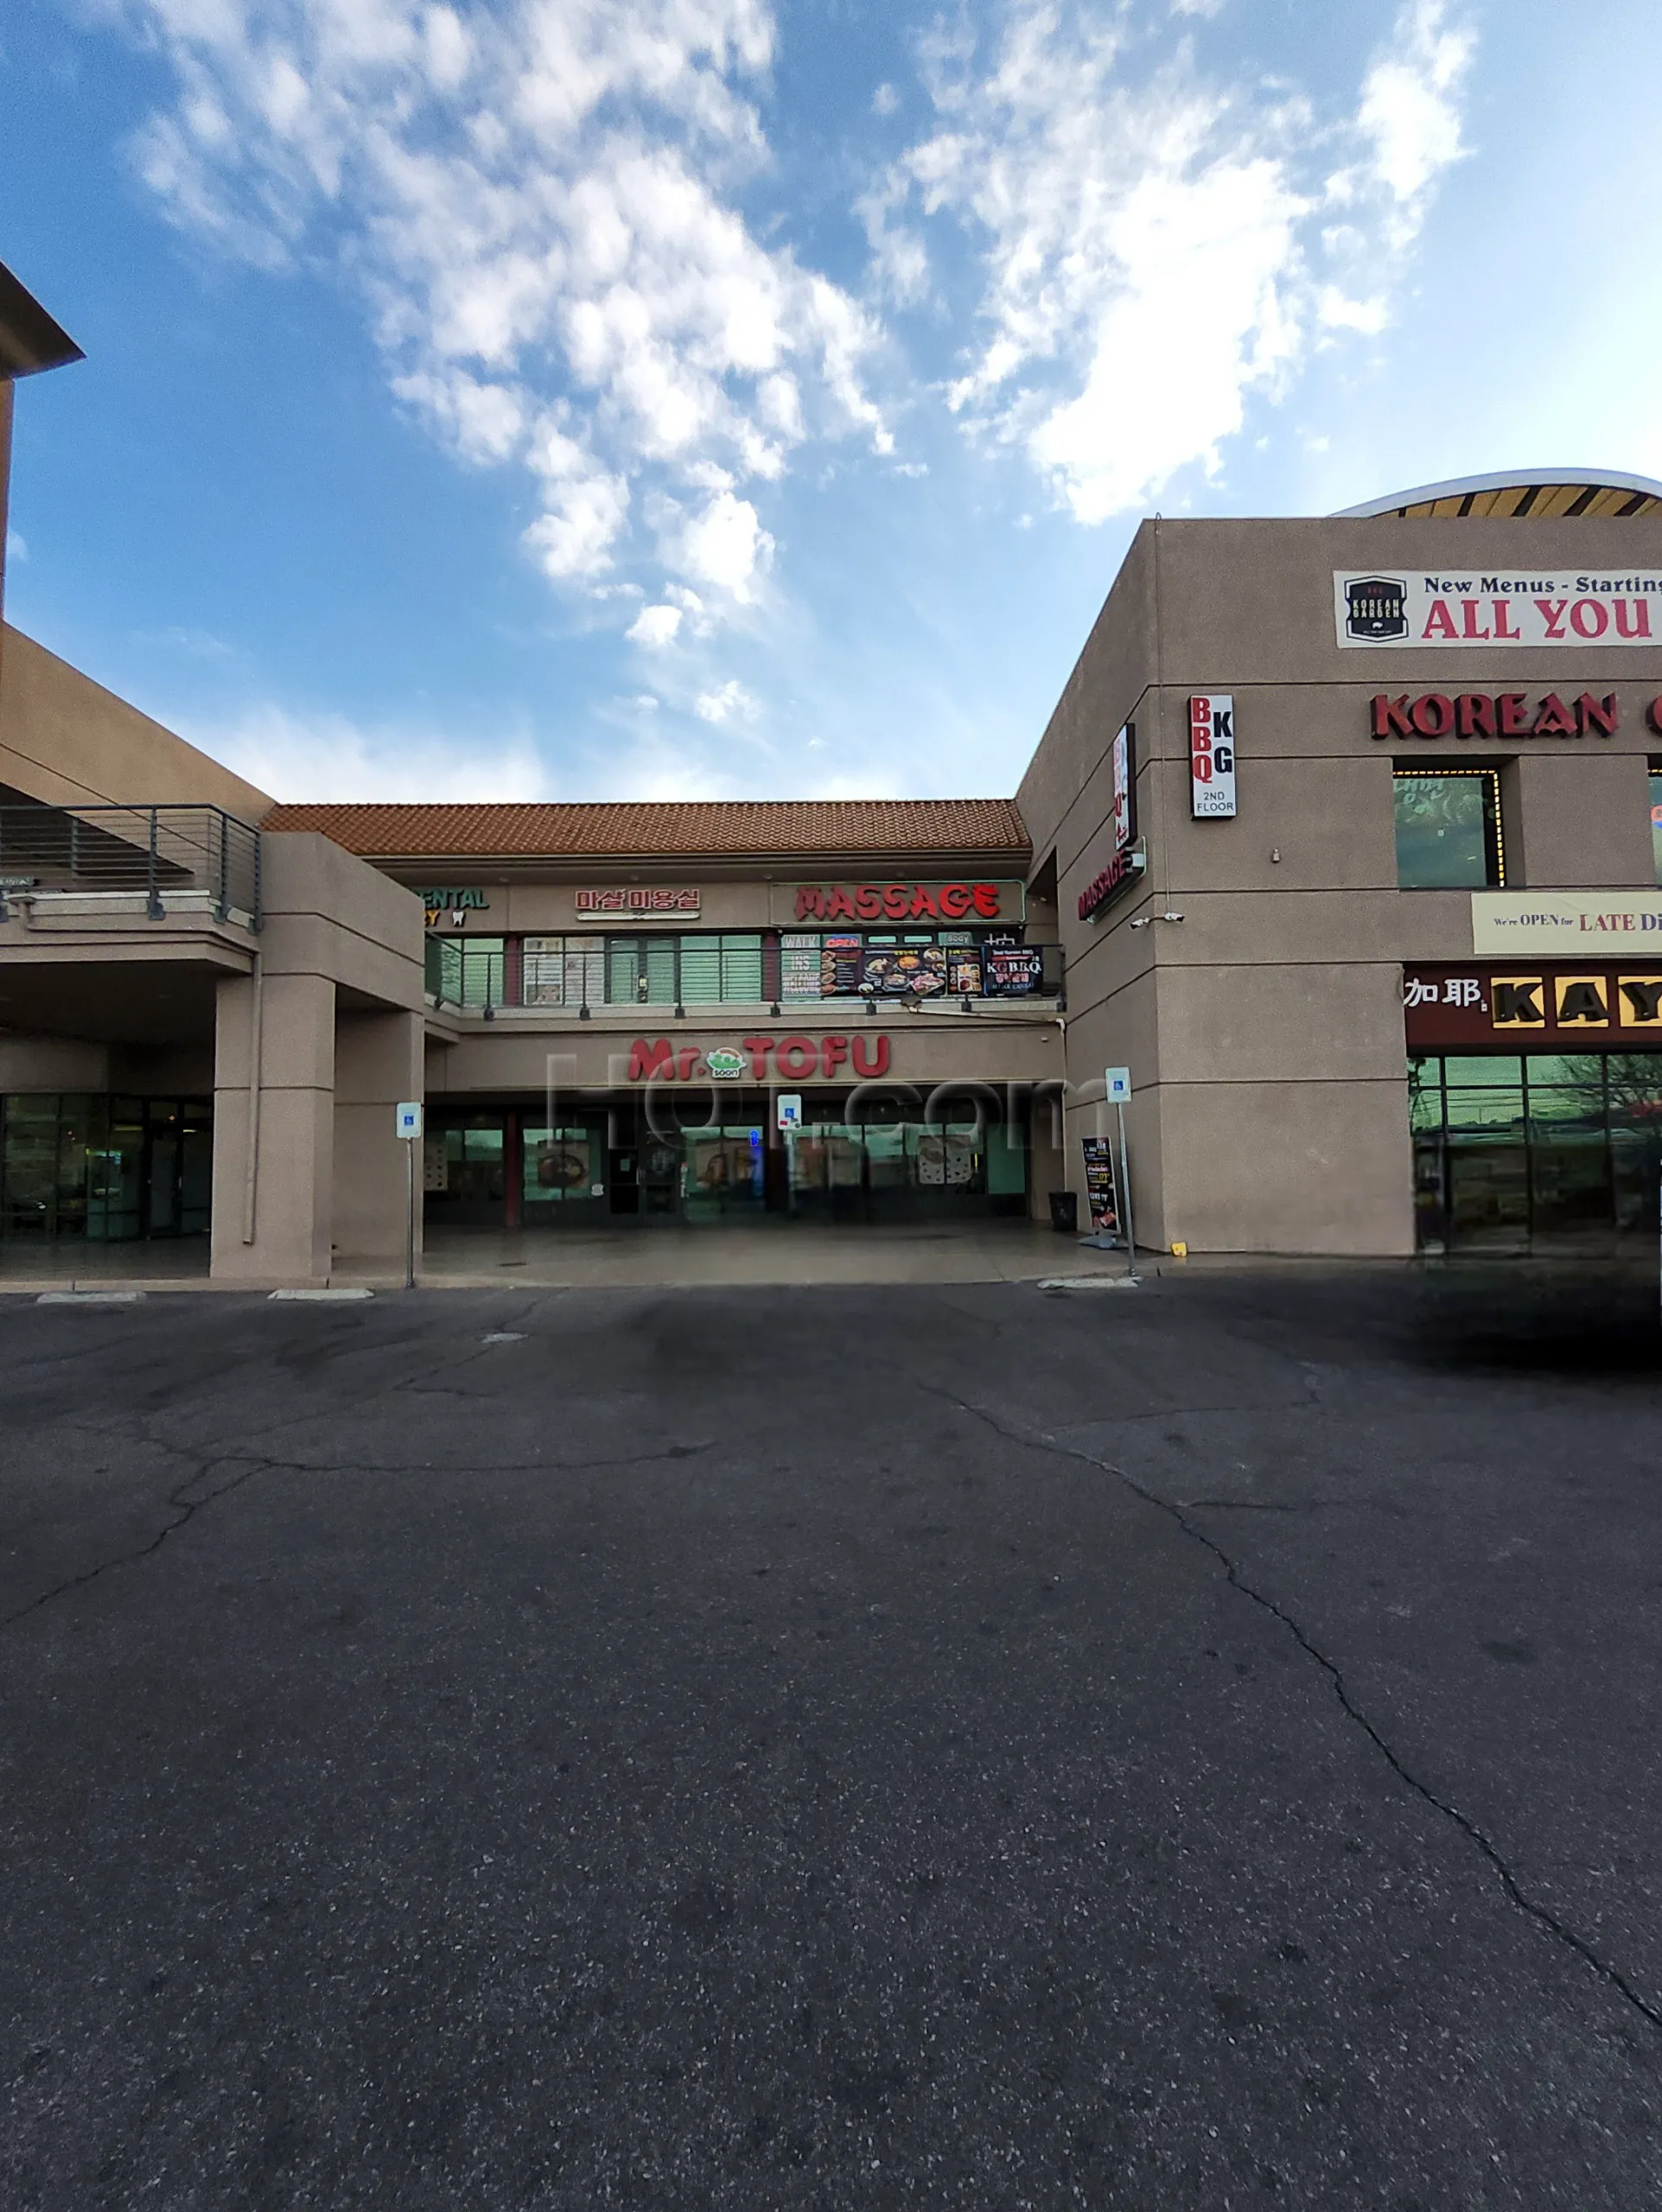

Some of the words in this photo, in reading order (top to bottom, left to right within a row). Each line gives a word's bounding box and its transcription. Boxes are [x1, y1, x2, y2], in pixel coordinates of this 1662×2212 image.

[1424, 577, 1473, 593] New
[1481, 577, 1555, 593] Menus
[1353, 598, 1399, 609] KOREAN
[1421, 600, 1520, 640] ALL
[1533, 598, 1652, 639] YOU
[1370, 691, 1620, 739] KOREAN
[1197, 803, 1234, 811] FLOOR
[1203, 791, 1226, 801] 2ND
[1079, 848, 1127, 921] MASSAGE
[419, 887, 489, 910] ENTAL
[628, 889, 701, 910] 미용실
[794, 885, 1001, 921] MASSAGE
[1493, 918, 1519, 926] We're
[1520, 913, 1559, 926] OPEN
[1579, 913, 1636, 931] LATE
[1403, 977, 1481, 1007] 加耶
[628, 1039, 706, 1080] Mr.
[743, 1035, 890, 1079] TOFU
[714, 1068, 738, 1077] soon
